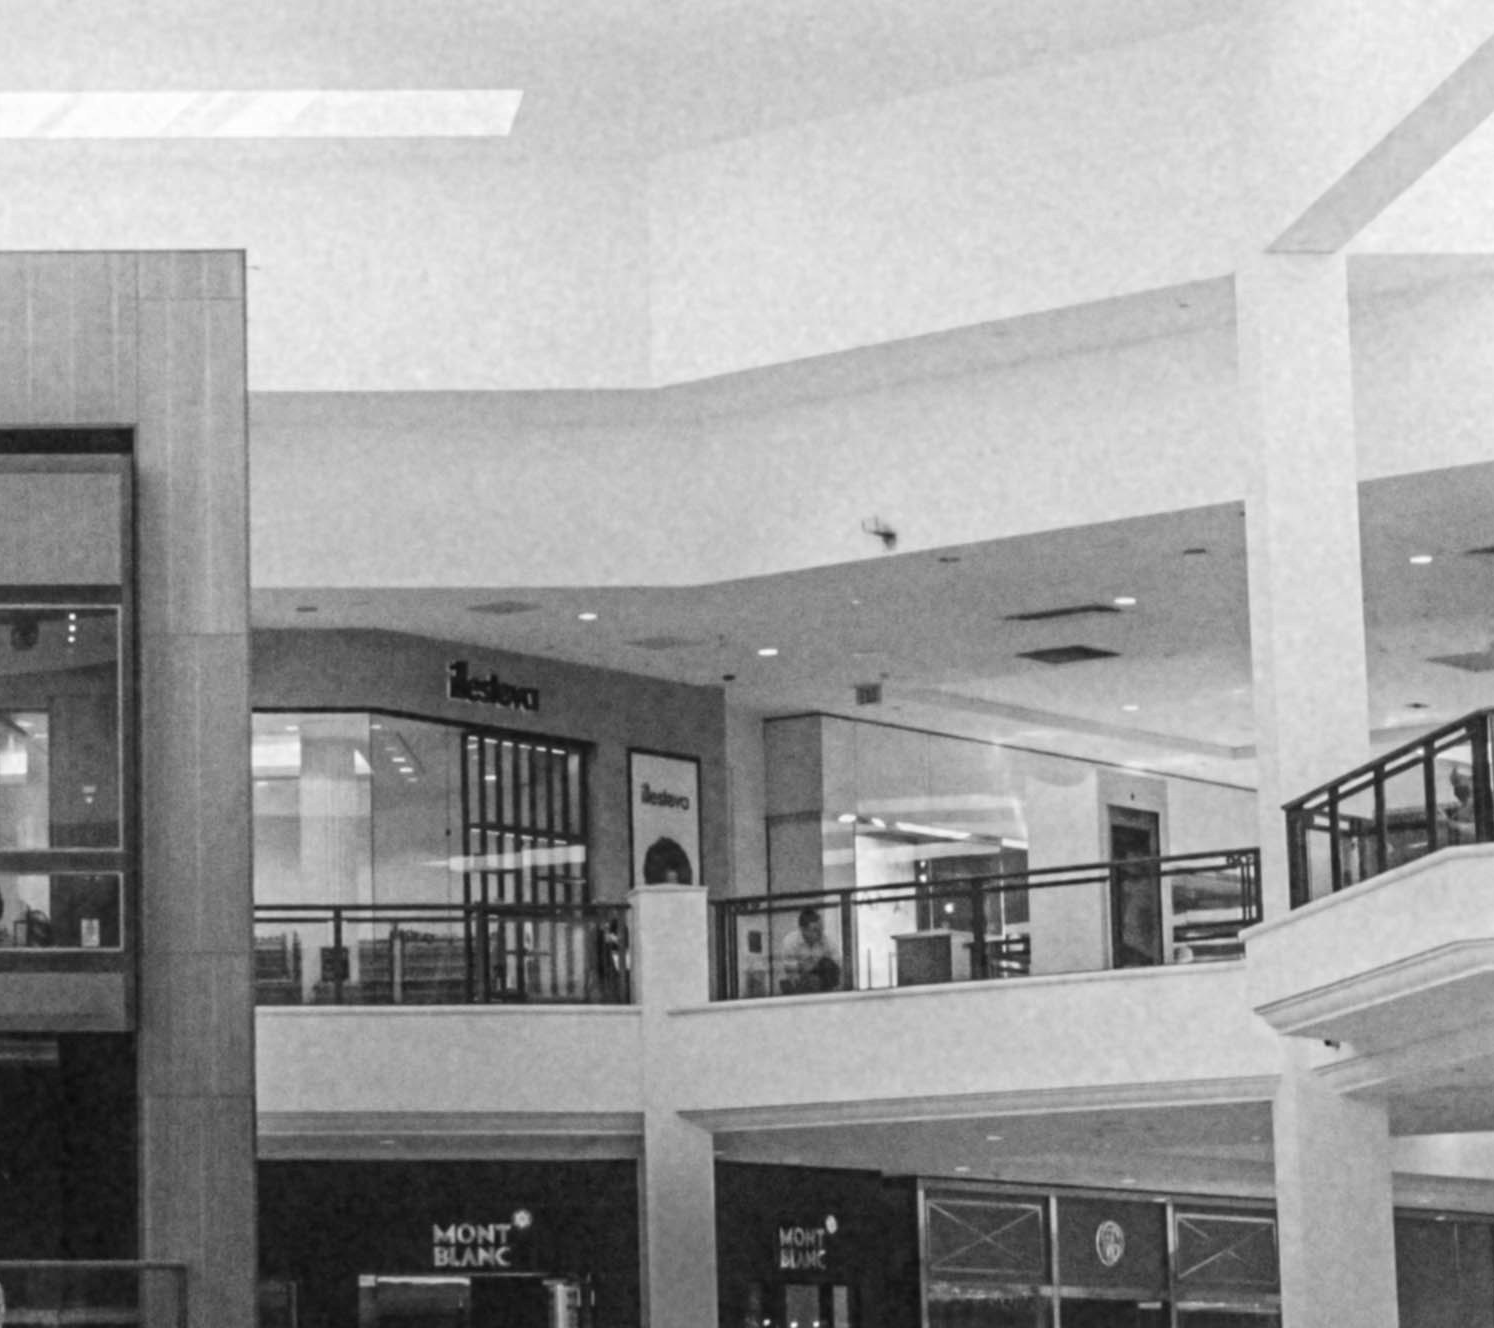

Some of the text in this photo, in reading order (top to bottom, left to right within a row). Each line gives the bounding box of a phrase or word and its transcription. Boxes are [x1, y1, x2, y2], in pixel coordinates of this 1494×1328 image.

[432, 1223, 512, 1245] MONT
[778, 1226, 825, 1248] MONT
[433, 1245, 512, 1268] BLANC
